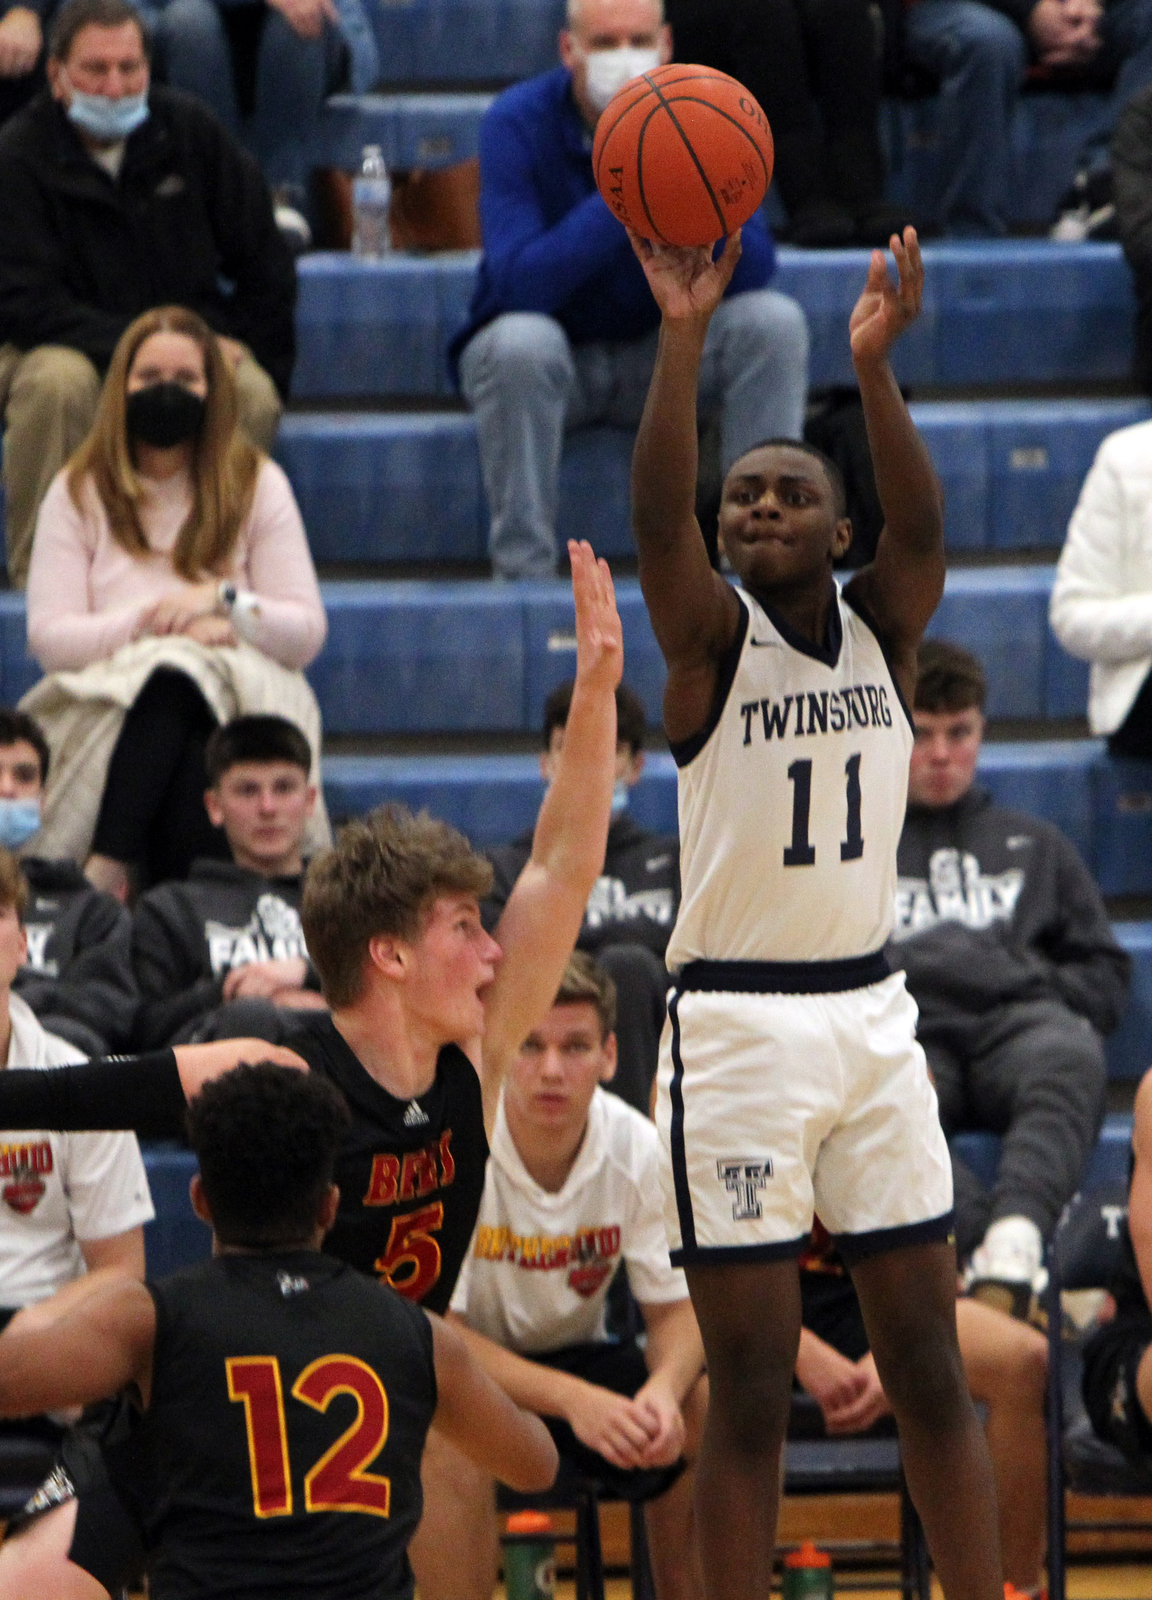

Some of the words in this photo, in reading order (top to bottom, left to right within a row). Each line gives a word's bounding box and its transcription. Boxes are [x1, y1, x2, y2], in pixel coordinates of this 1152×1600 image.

[740, 684, 892, 748] TWINSBURG
[783, 751, 864, 868] 11
[373, 1200, 444, 1304] 5
[224, 1353, 391, 1519] 12
